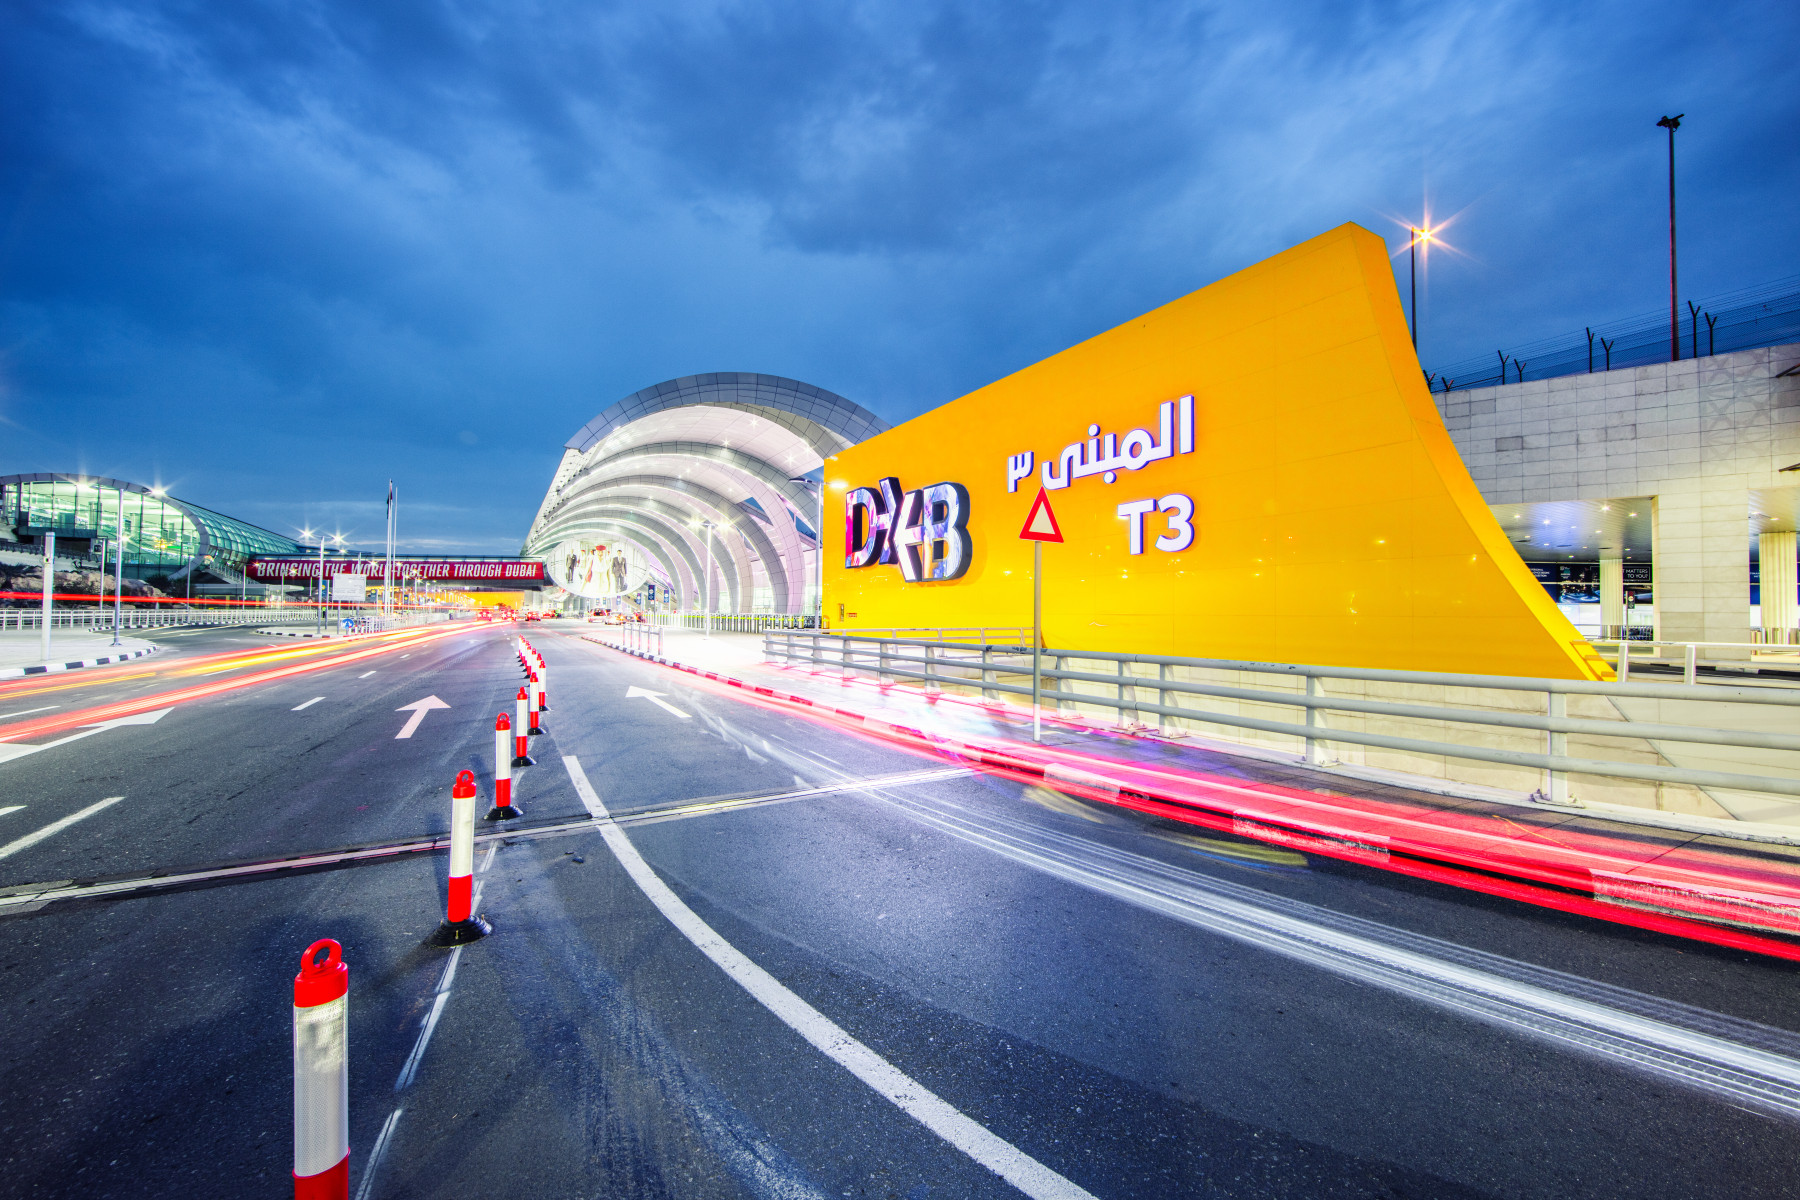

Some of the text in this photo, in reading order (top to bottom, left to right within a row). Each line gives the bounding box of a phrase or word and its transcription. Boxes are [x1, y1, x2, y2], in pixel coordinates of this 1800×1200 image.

[1007, 394, 1195, 493] المبنى ٣
[845, 476, 973, 583] DXB
[1117, 493, 1195, 556] T3
[257, 562, 537, 577] BRINGING THE WORL TOGETHER THROUGH DUBAI
